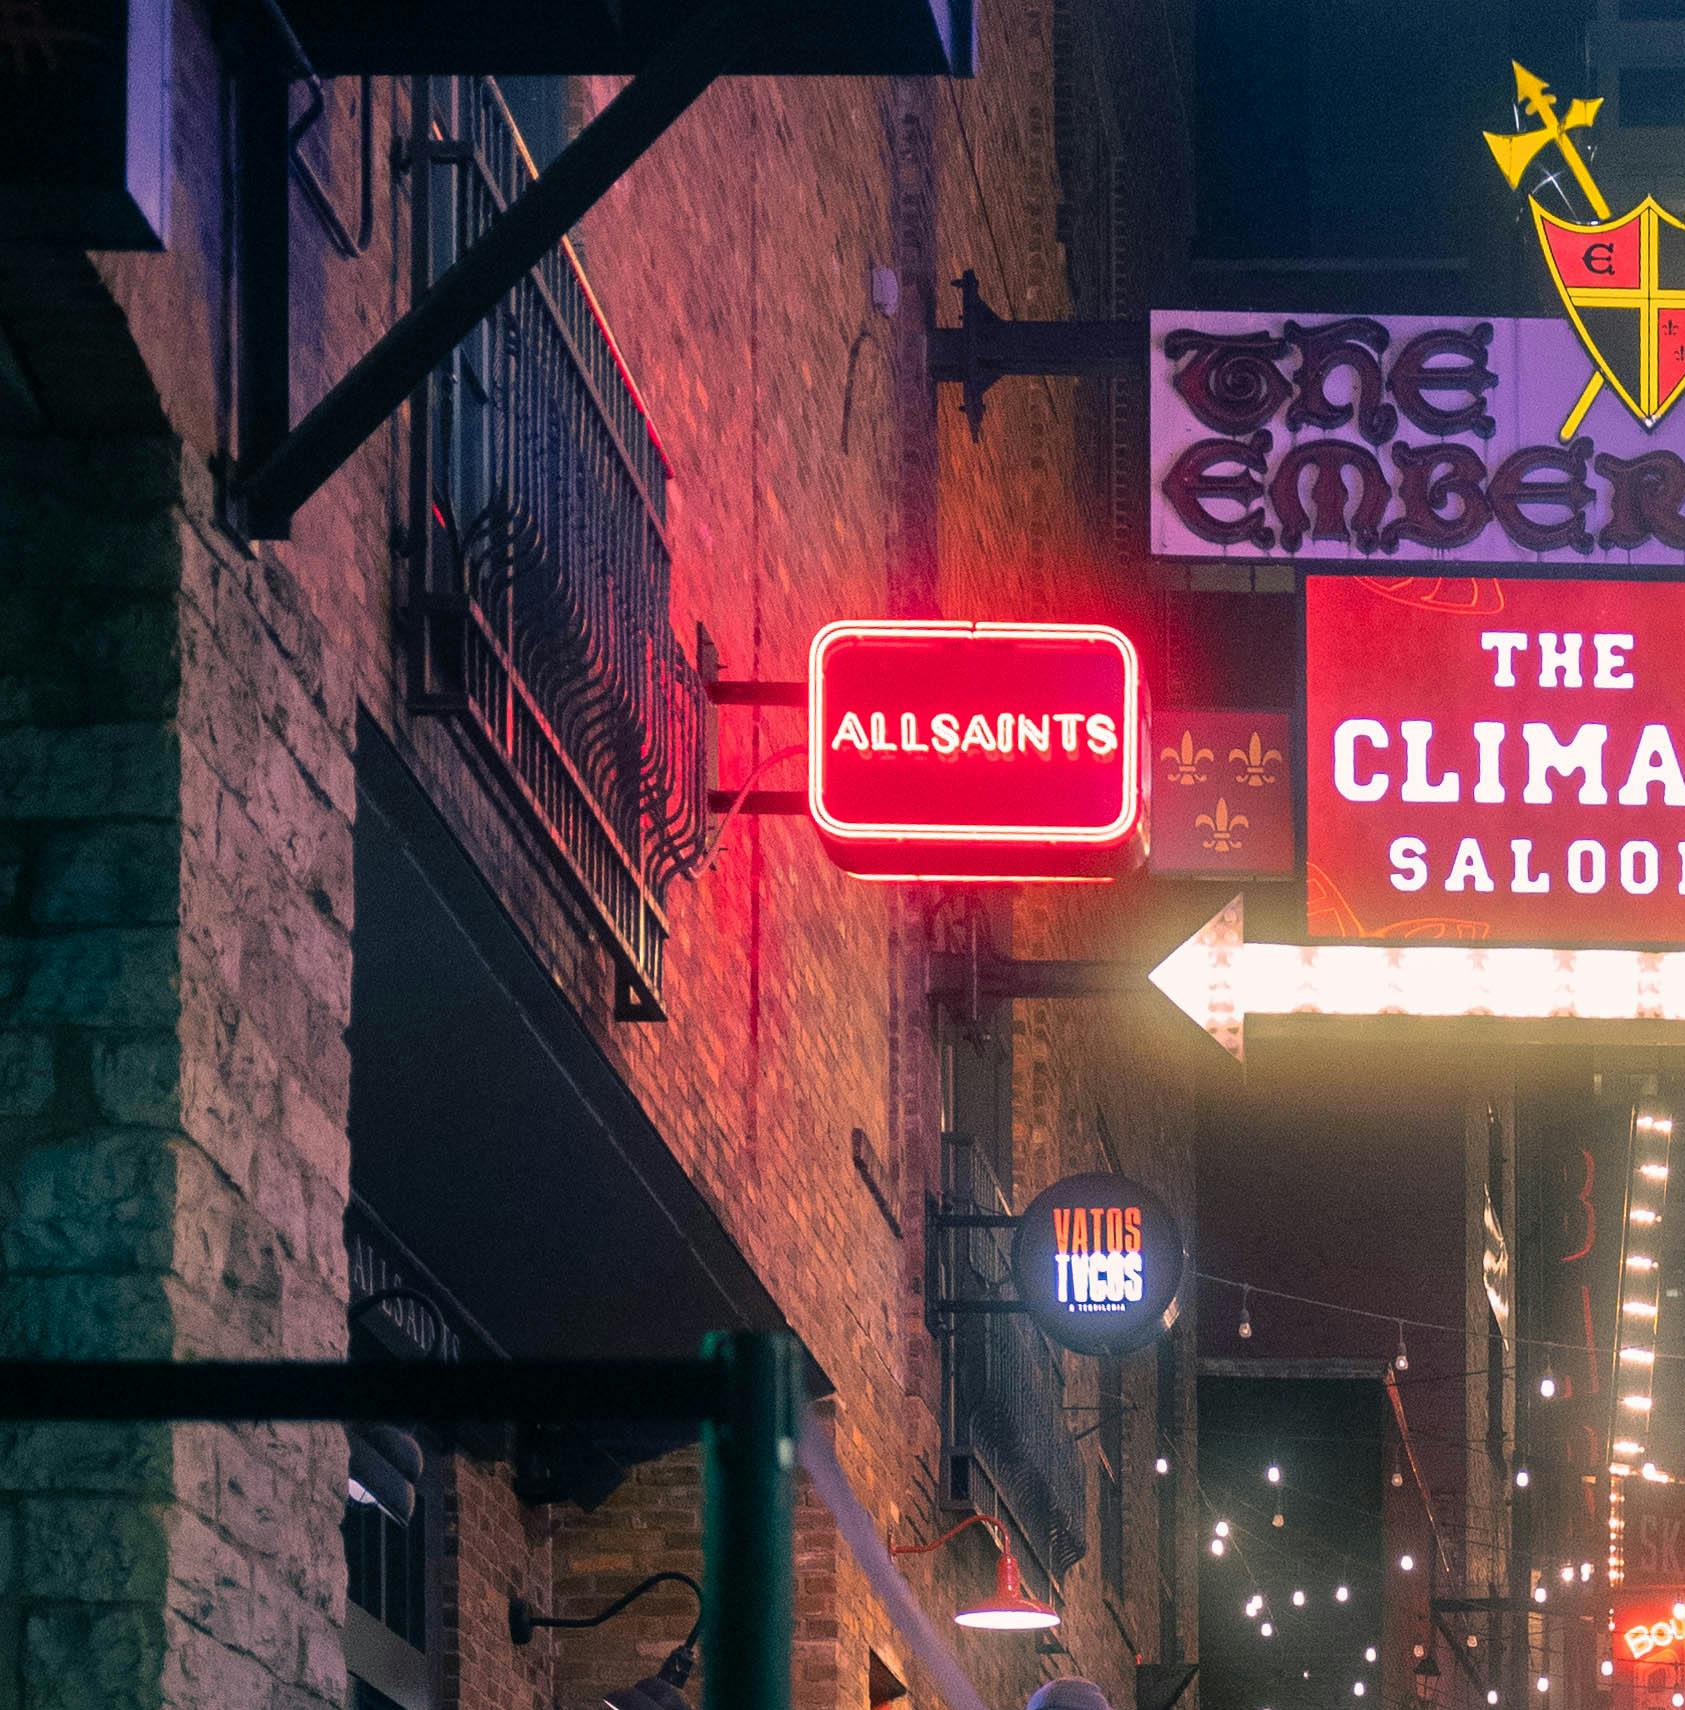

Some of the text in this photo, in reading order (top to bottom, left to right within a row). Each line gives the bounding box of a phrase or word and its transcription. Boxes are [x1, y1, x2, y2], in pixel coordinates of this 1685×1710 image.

[1164, 318, 1499, 446] THE
[1480, 630, 1635, 689] THE
[831, 711, 1119, 755] ALLSAINTS
[1053, 1206, 1142, 1254] VATOS
[1055, 1251, 1143, 1303] TACOS
